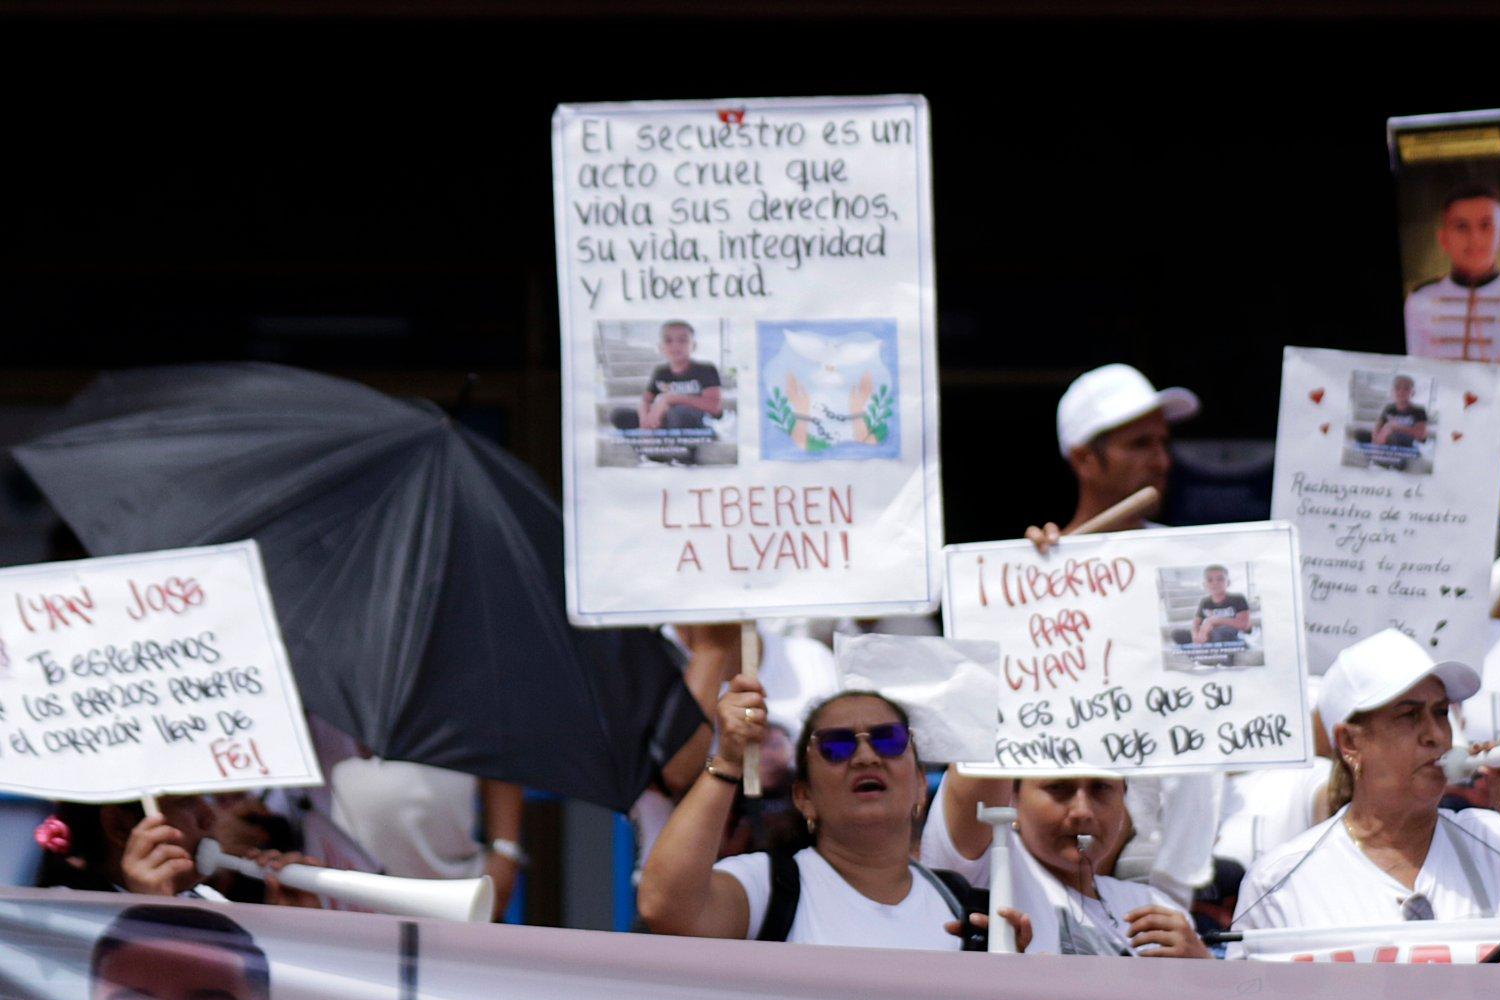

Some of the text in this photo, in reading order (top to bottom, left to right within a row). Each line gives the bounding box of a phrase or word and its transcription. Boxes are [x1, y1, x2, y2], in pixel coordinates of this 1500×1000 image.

[581, 115, 911, 152] El secuestro es un
[578, 155, 847, 192] acto cruel que
[574, 194, 653, 227] viola
[669, 197, 729, 224] sus
[577, 236, 616, 264] su
[718, 227, 885, 269] integridad
[580, 276, 602, 310] y
[661, 484, 852, 529] LIBEREN
[1403, 483, 1424, 498] el
[1380, 506, 1400, 522] de
[676, 532, 849, 572] A LYAN!
[1029, 608, 1091, 648] PARA
[1018, 701, 1053, 729] ES
[1066, 685, 1132, 730] JUSTO
[1145, 685, 1196, 717] QUE
[1202, 681, 1234, 710] SU
[1169, 724, 1206, 757] DE
